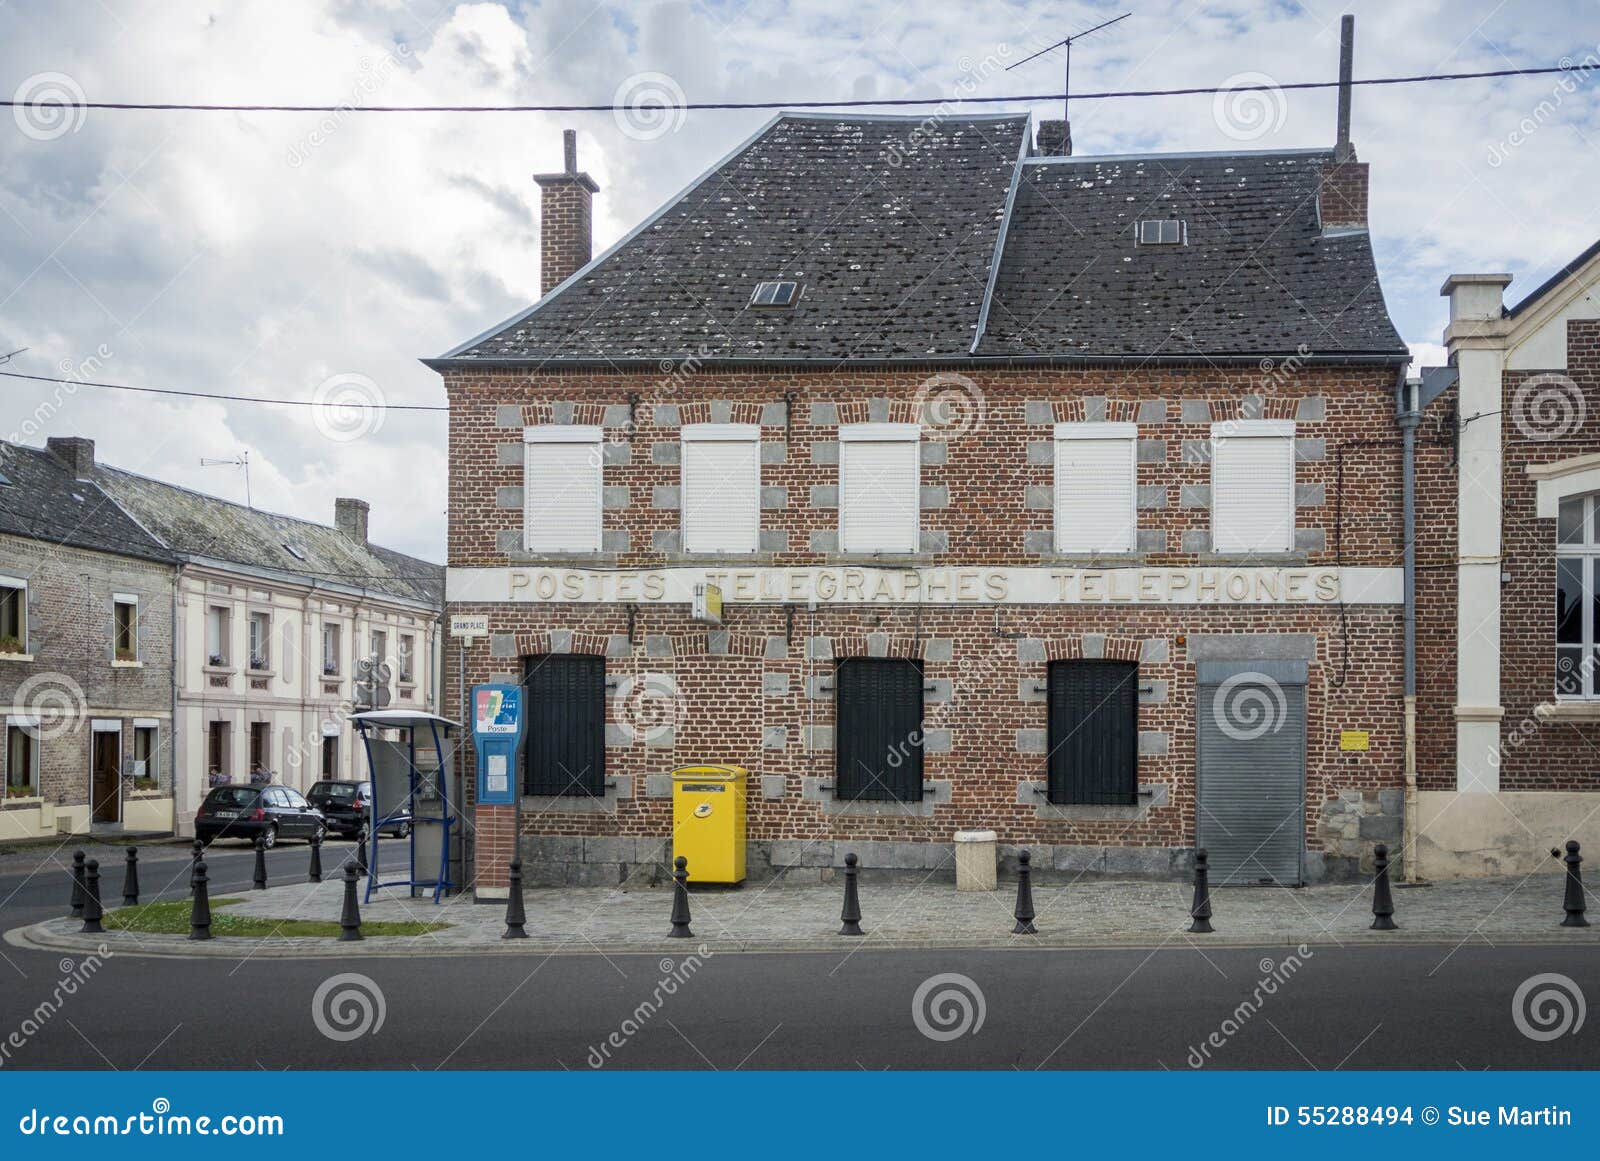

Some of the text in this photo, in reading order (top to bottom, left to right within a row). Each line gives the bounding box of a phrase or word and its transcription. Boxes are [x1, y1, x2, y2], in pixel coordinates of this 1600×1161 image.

[508, 571, 1340, 601] POSTES TELEGRAPHES TELEPHONES
